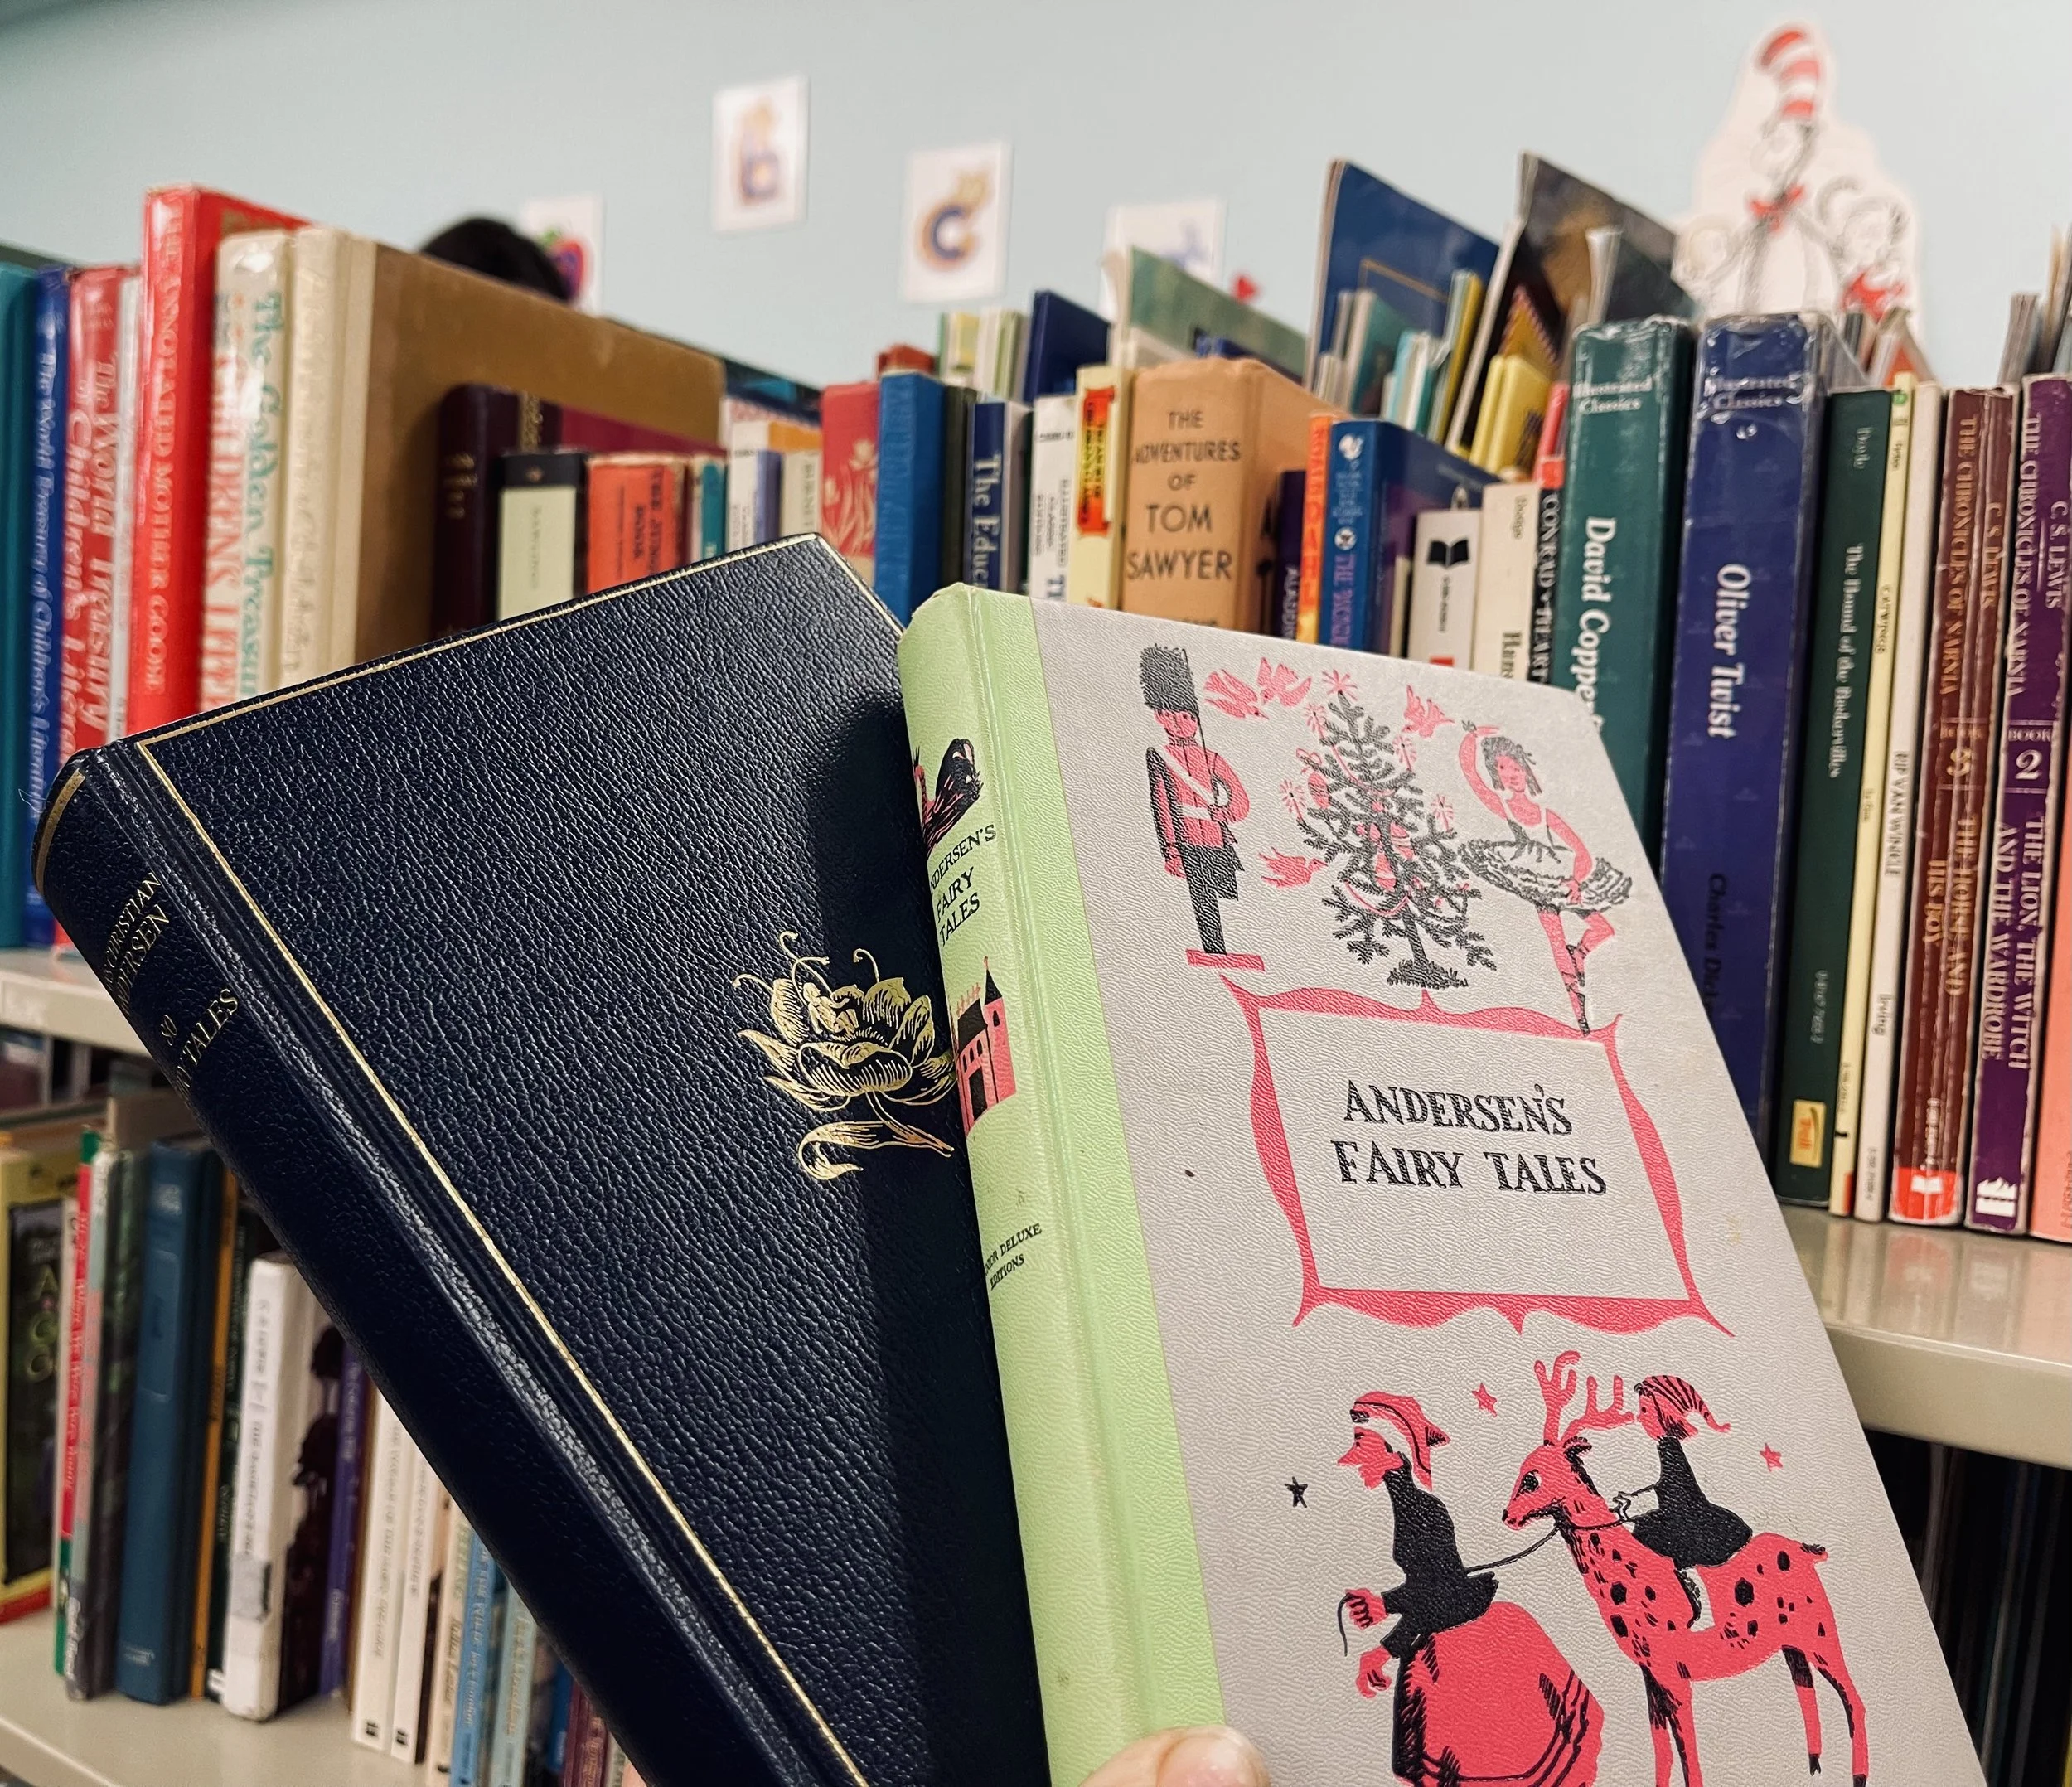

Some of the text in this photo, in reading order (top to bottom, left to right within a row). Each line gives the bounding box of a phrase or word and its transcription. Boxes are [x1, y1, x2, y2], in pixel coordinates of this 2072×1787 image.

[96, 351, 118, 408] The
[153, 277, 179, 458] ANNOTATED
[35, 399, 56, 468] World
[1133, 440, 1242, 464] ADVENTURES
[1167, 410, 1204, 429] THE
[1852, 426, 1873, 470] Doyle
[89, 413, 121, 539] World
[242, 291, 283, 695] The Golden Treasur
[1167, 473, 1196, 492] OF
[62, 409, 94, 620] Children's
[149, 461, 177, 590] MOTHER
[971, 451, 1003, 588] The Educ
[1145, 503, 1213, 535] TOM
[1126, 550, 1233, 581] SAWYER
[1531, 493, 1560, 683] CONRAD HEART
[1939, 416, 1978, 695] THE CHRONICLES OF NARNIA
[1979, 546, 2006, 610] LEWIS
[2006, 412, 2042, 698] THE CHRONICLES OF NARNIA
[2045, 545, 2068, 610] LEWIS
[77, 557, 114, 733] Treasury
[143, 594, 170, 693] GOOSE
[1570, 516, 1617, 733] David Coppe
[1707, 563, 1751, 739] Oliver Twist
[1874, 583, 1891, 654] CATWINGS
[1501, 631, 1523, 678] Hans
[1828, 542, 1864, 778] The Hound of the Baskervilles
[60, 634, 86, 768] Litera
[2007, 728, 2052, 743] BOOK
[1889, 777, 1909, 814] VAN
[1893, 751, 1910, 774] RIP
[2015, 748, 2044, 781] 2
[929, 823, 997, 890] NDERSEN'S
[104, 871, 162, 970] CHRISTIAN
[936, 865, 975, 923] FAIRY
[939, 891, 980, 947] TALES
[1923, 855, 1949, 943] HIS BOY
[1945, 815, 1978, 995] THE HORSE AND
[1703, 872, 1727, 1019] Charles Dick
[1981, 821, 2019, 1062] AND THE WARDROBE
[2007, 811, 2045, 1072] THE LION, THE WITCH
[182, 987, 240, 1067] TALES
[1871, 993, 1894, 1037] Irving
[1343, 1079, 1573, 1136] ANDERSEN'S
[1330, 1140, 1607, 1196] FAIRY TALES
[989, 1252, 1025, 1291] EDITIONS
[999, 1222, 1043, 1257] DELUXE
